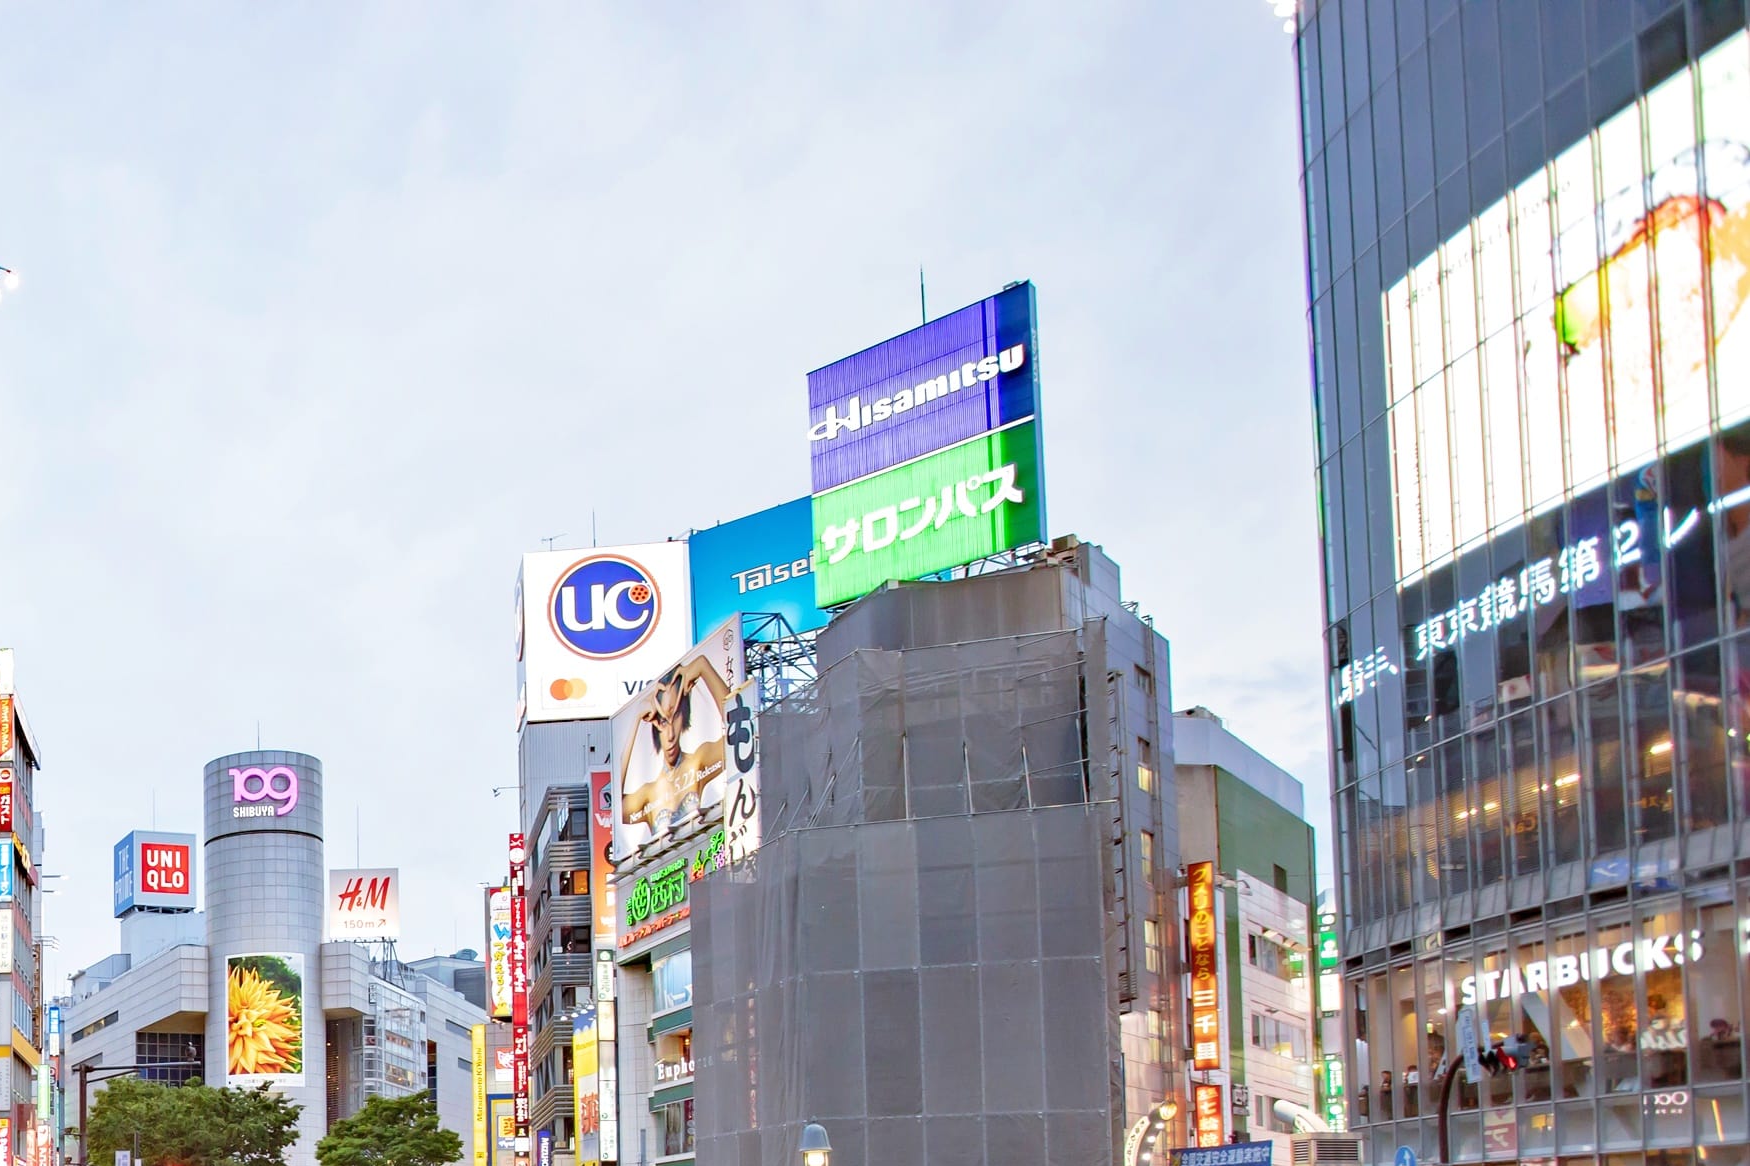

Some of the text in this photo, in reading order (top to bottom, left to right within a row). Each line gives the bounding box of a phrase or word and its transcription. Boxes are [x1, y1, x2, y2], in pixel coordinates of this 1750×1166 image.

[807, 344, 1024, 442] Hisamitsu
[821, 463, 1023, 565] サロンパス
[228, 766, 299, 816] 109
[0, 795, 11, 825] ガスト
[233, 805, 275, 818] SHIBUYA
[146, 849, 181, 867] UNI
[146, 871, 185, 891] QLO
[338, 876, 391, 911] H&M
[344, 919, 375, 929] 150m
[1461, 928, 1705, 1006] STARBUCKS
